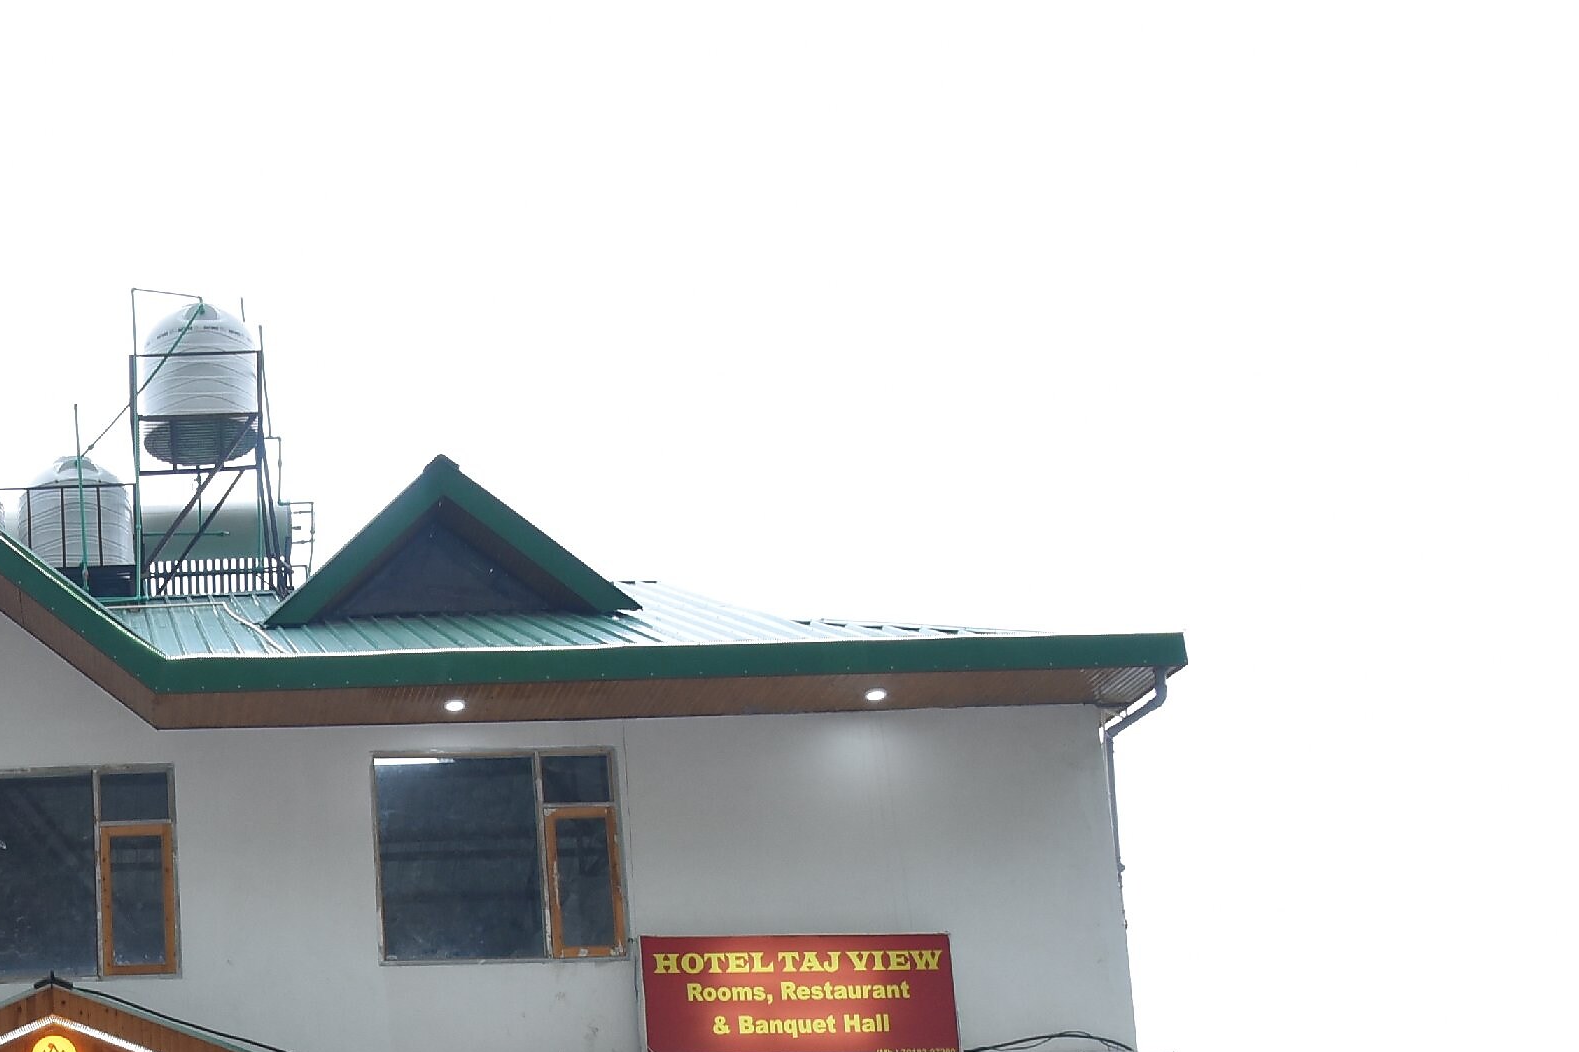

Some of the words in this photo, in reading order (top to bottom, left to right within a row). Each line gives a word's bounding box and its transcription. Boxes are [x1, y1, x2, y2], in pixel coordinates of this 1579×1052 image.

[652, 951, 775, 974] HOTEL
[777, 950, 841, 973] TAJ
[845, 949, 943, 971] VIEW
[686, 982, 774, 1006] Rooms,
[780, 980, 911, 1000] Restaurant
[712, 1015, 731, 1035] &
[738, 1013, 837, 1039] Banquet
[843, 1013, 891, 1033] Hall
